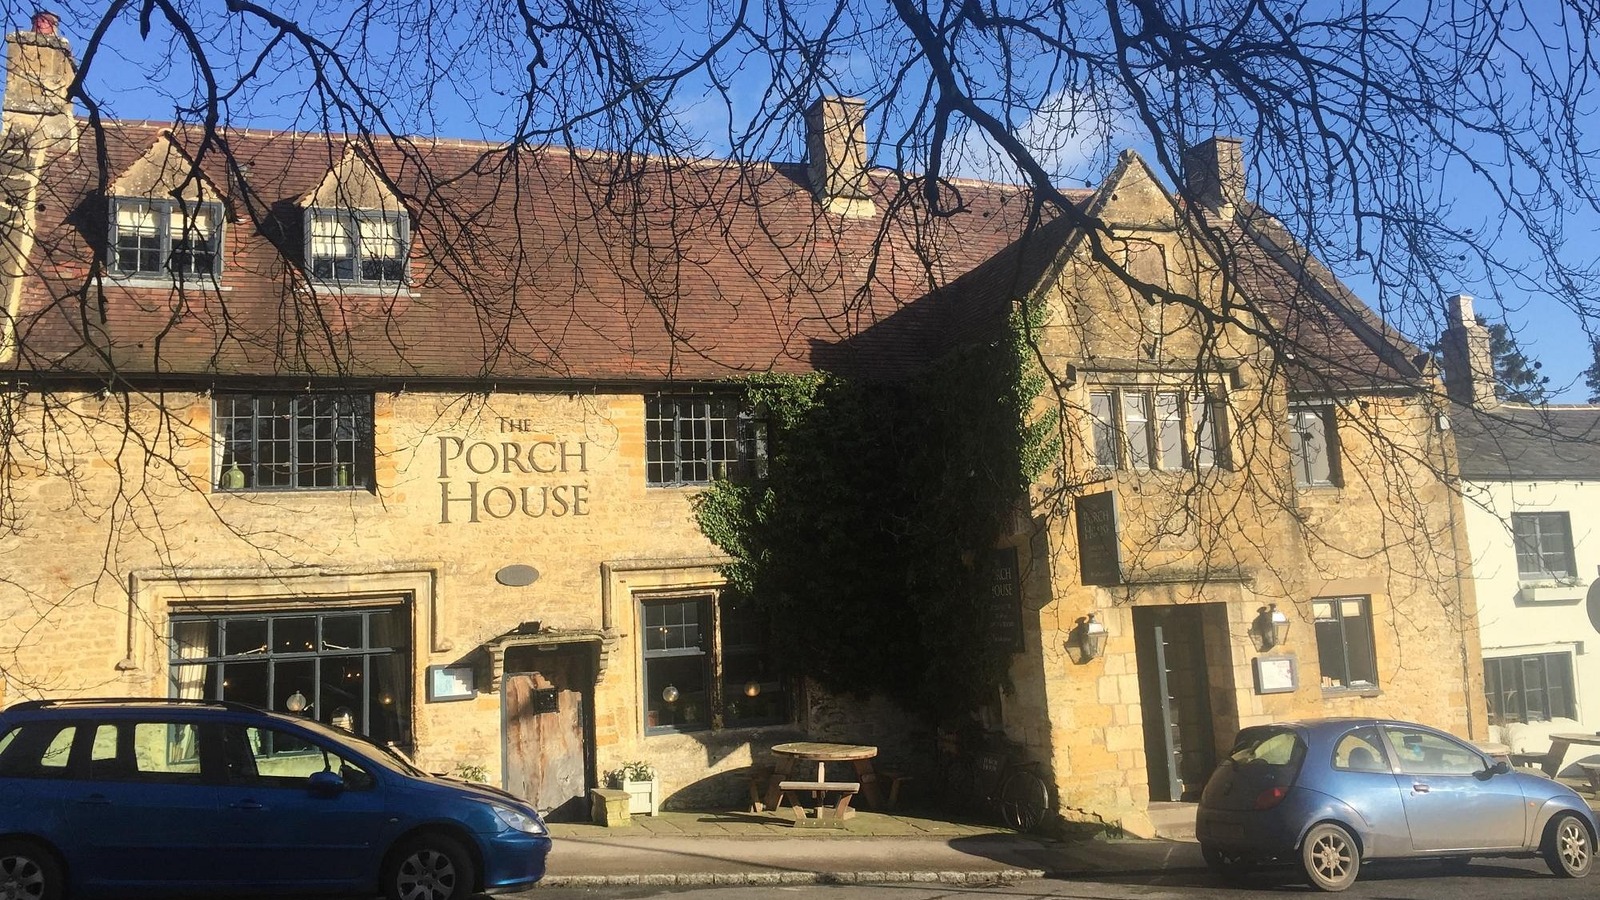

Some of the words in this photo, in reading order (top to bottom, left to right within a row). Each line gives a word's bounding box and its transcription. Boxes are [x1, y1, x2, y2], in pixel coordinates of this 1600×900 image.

[495, 416, 532, 434] THE
[437, 435, 589, 479] PORCH
[438, 481, 591, 524] HOUSE
